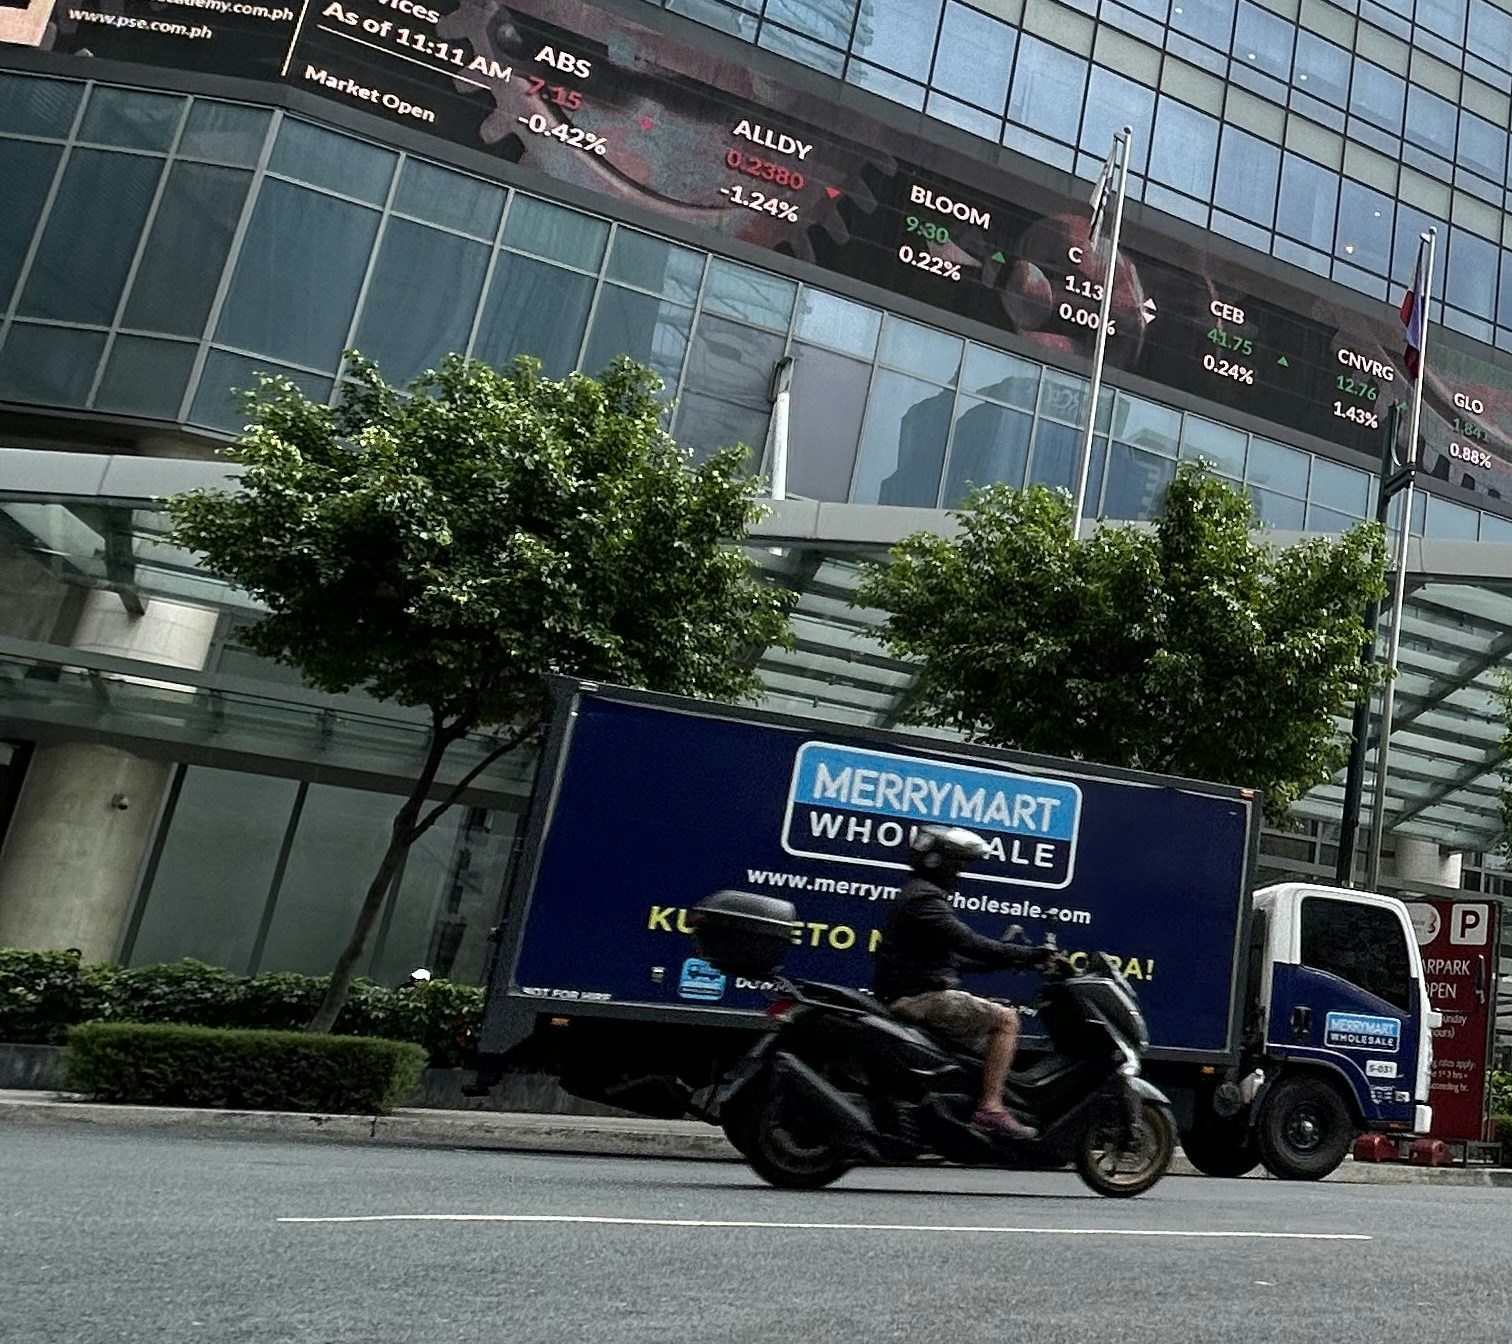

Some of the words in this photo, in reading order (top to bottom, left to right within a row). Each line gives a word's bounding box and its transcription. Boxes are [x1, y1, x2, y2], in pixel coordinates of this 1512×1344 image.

[68, 8, 213, 39] www.pse.com.ph
[322, 2, 359, 27] As
[362, 17, 393, 38] of
[396, 27, 464, 67] 11:11
[468, 55, 513, 83] AM
[534, 45, 592, 79] ABS
[304, 64, 380, 104] Market
[382, 94, 437, 124] Open
[527, 75, 583, 112] 7.15
[518, 114, 608, 156] -0.42%
[732, 119, 813, 160] ALLDY
[726, 148, 804, 190] 0.2380
[720, 185, 800, 224] -1.24%
[909, 184, 991, 230] BLOOM
[905, 216, 950, 244] 9.30
[898, 245, 962, 282] 0.22%
[1210, 300, 1245, 325] CEB
[1207, 327, 1253, 356] 41.75
[1203, 354, 1254, 385] 0.24%
[1338, 349, 1394, 382] CNVRG
[1336, 375, 1377, 401] 12.76
[1453, 392, 1484, 414] GLO
[1333, 401, 1379, 429] 1.43%
[1450, 442, 1492, 469] 0.88%
[812, 762, 1061, 832] MERRYMART
[809, 811, 1056, 868] WHOALE
[1460, 910, 1480, 938] P
[1330, 1018, 1393, 1035] MERRYMART
[1330, 1033, 1394, 1046] WHOLESALE
